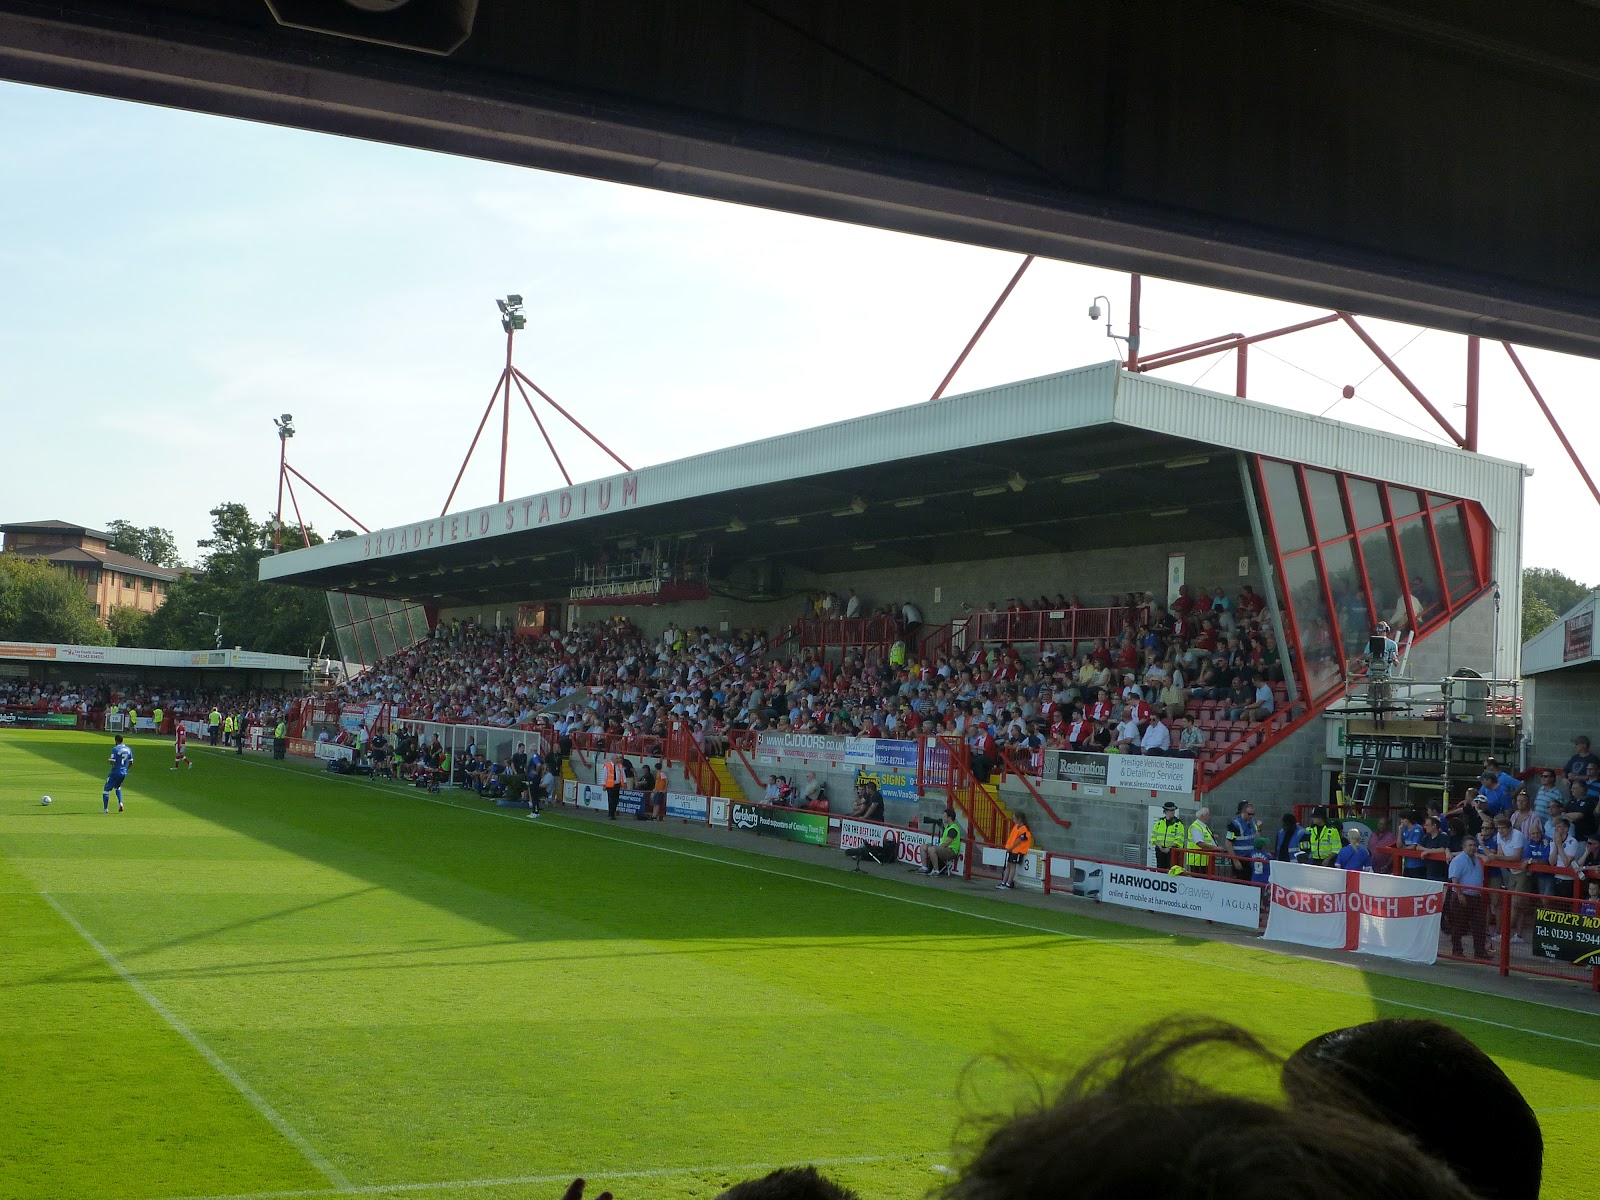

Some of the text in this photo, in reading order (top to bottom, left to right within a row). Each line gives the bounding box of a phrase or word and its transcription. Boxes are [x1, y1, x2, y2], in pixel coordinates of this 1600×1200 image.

[363, 475, 638, 557] BROADFIELD STADIUM
[1060, 759, 1106, 776] Restoration
[1121, 758, 1185, 771] Prestige Vehicle Repair
[881, 773, 906, 787] SIGNS
[1120, 767, 1184, 781] & Detailing Services
[716, 805, 721, 815] 2
[732, 804, 758, 827] Carlsberg
[759, 816, 825, 835] Proud supporters of Crawley Town FC
[842, 823, 851, 832] FOR
[851, 825, 859, 834] THE
[859, 826, 869, 836] BEST
[900, 831, 927, 845] Crawley
[1024, 859, 1030, 871] 3
[1110, 872, 1215, 903] HARWOODS Crawley
[1108, 890, 1124, 899] online
[1129, 893, 1148, 903] mobile
[1148, 896, 1154, 904] at
[1154, 897, 1202, 912] harwoods.uk.com
[1221, 897, 1259, 912] JAGUAR
[1275, 886, 1438, 918] PORTSMOUTH FC
[1536, 908, 1580, 926] WEBBER
[1536, 925, 1550, 937] Tel:
[1550, 928, 1574, 941] 01293
